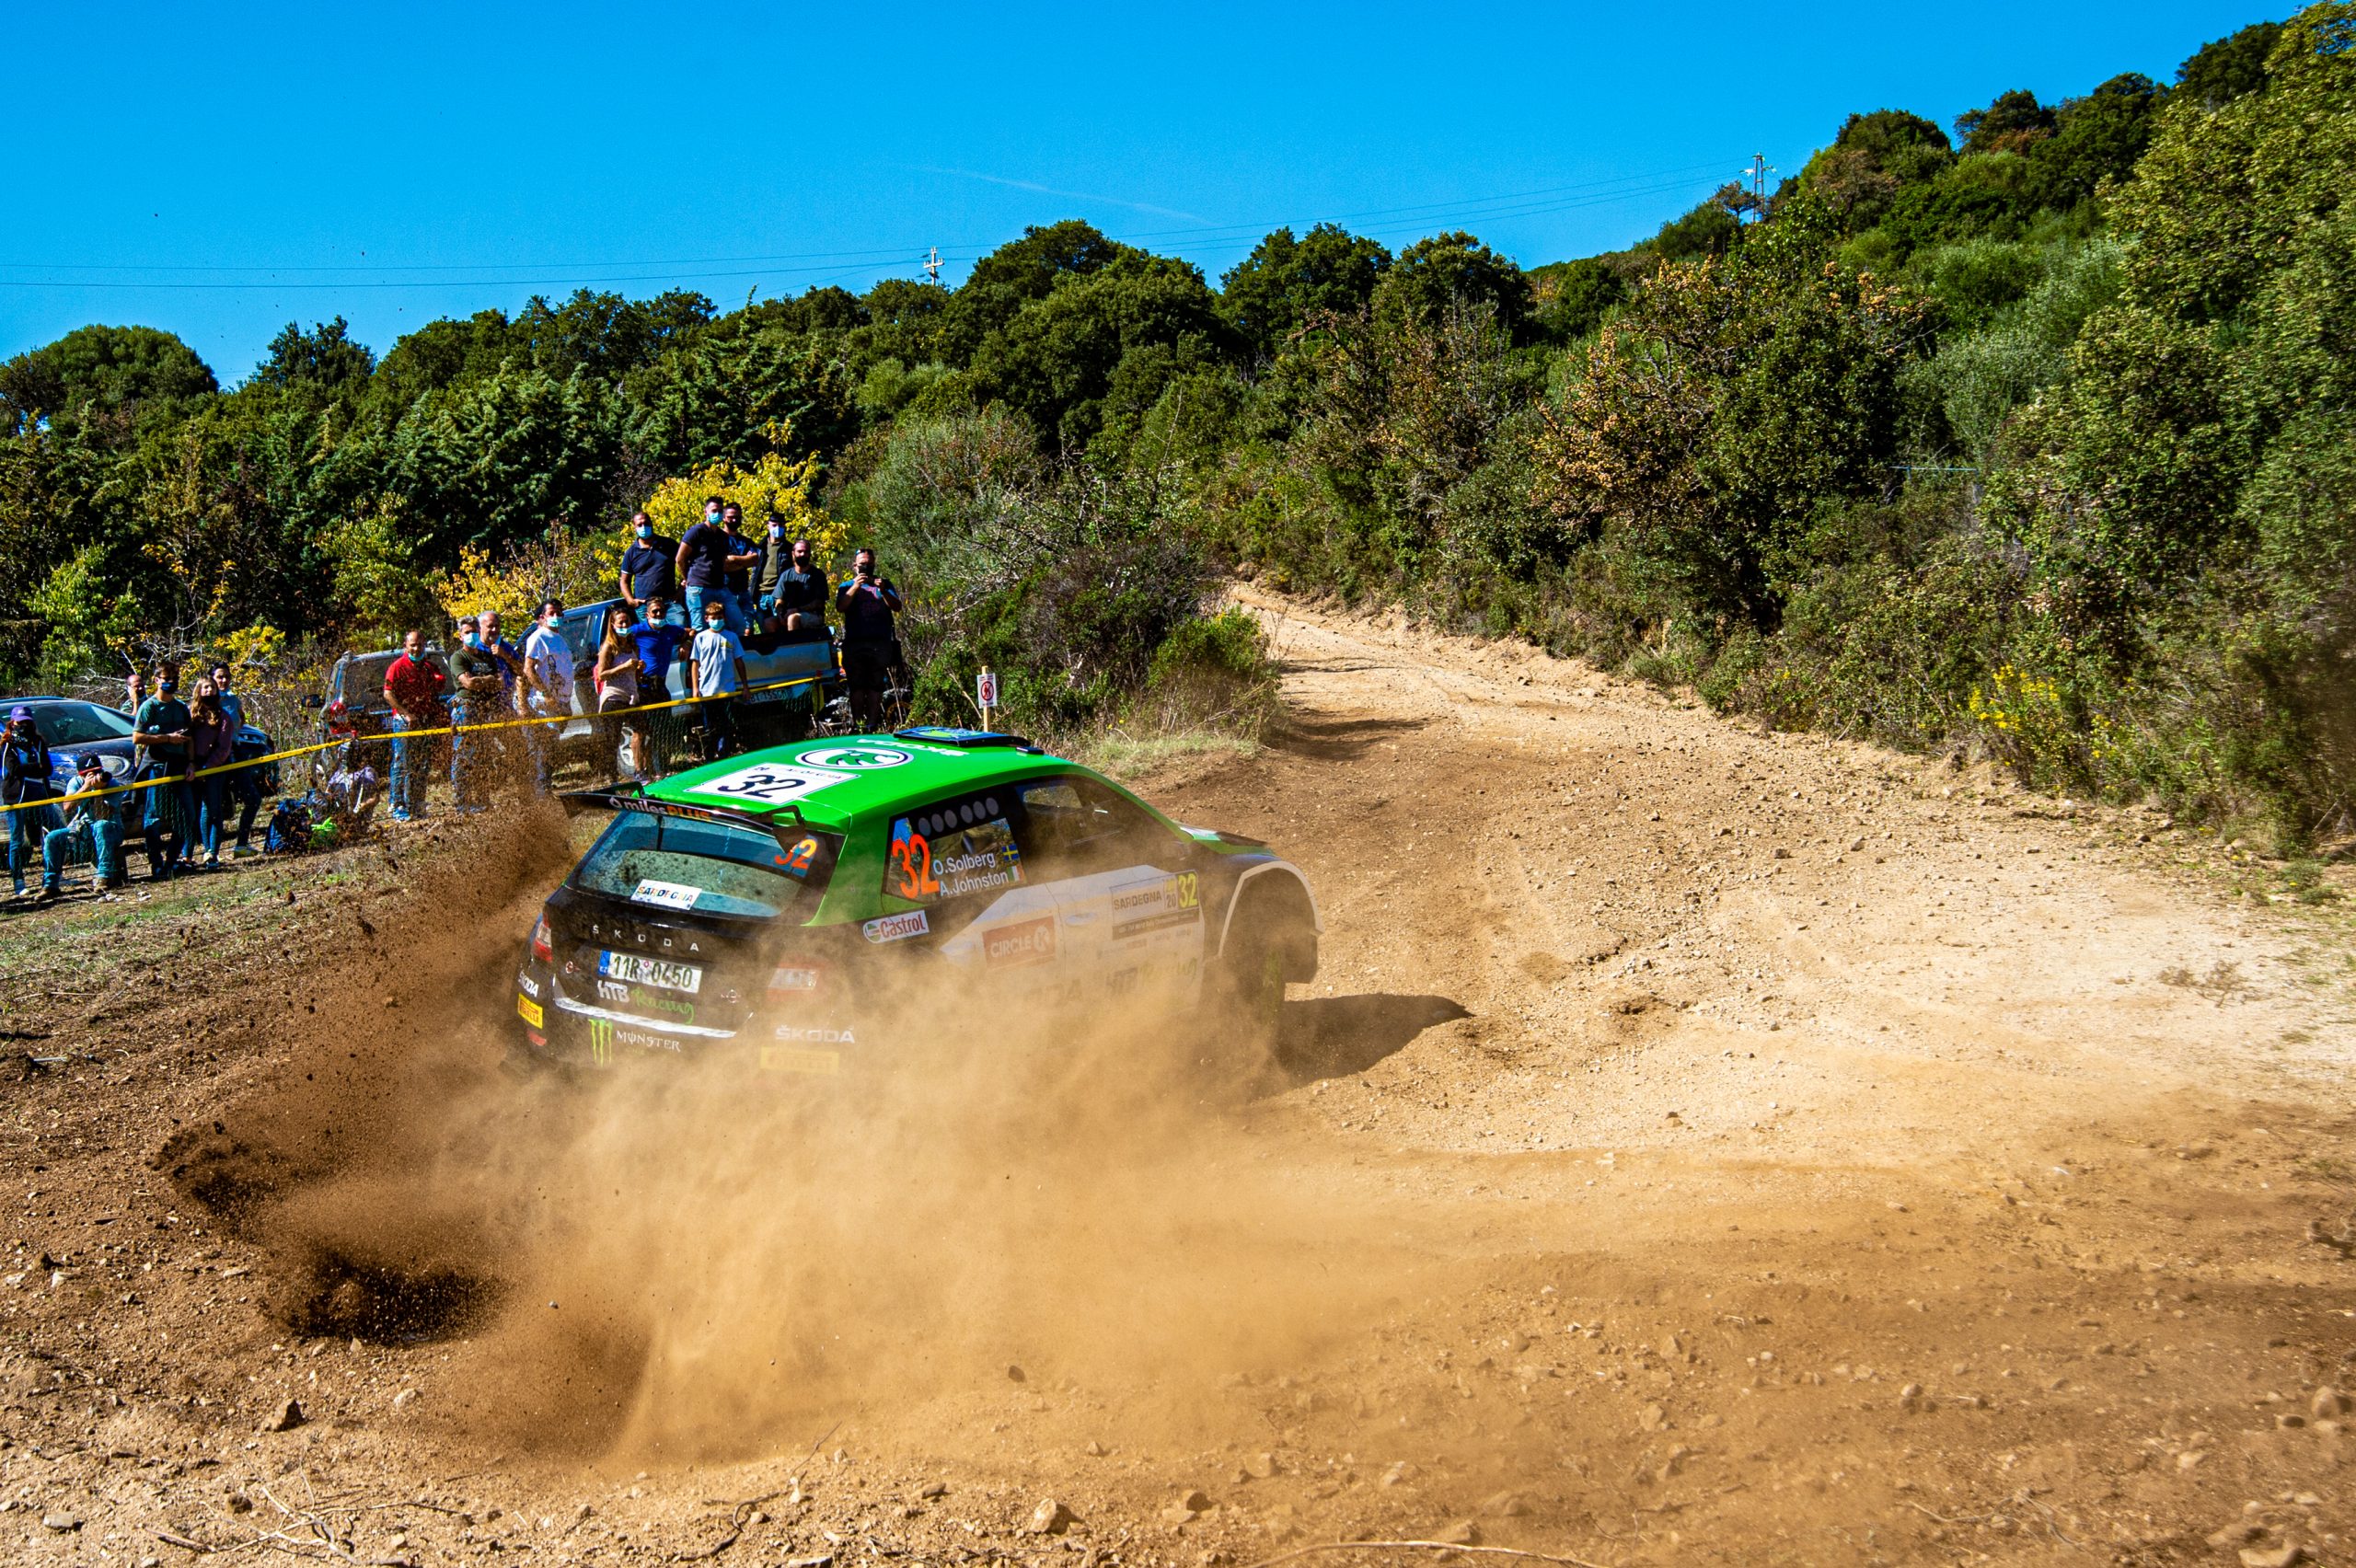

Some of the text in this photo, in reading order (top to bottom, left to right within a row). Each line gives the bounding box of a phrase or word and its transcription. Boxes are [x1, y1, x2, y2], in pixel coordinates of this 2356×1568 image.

[717, 774, 806, 799] 32
[891, 833, 940, 899] 32
[932, 851, 996, 875] O.Solberg
[940, 870, 1009, 897] A.Johnston
[1178, 872, 1198, 908] 32
[1113, 890, 1162, 911] SARDEGNA
[880, 914, 926, 939] Castrol
[990, 934, 1032, 958] CIRCLE
[613, 955, 640, 980] 11R
[651, 960, 693, 988] 0450
[630, 986, 697, 1025] Racing
[616, 1030, 682, 1054] MONSTER
